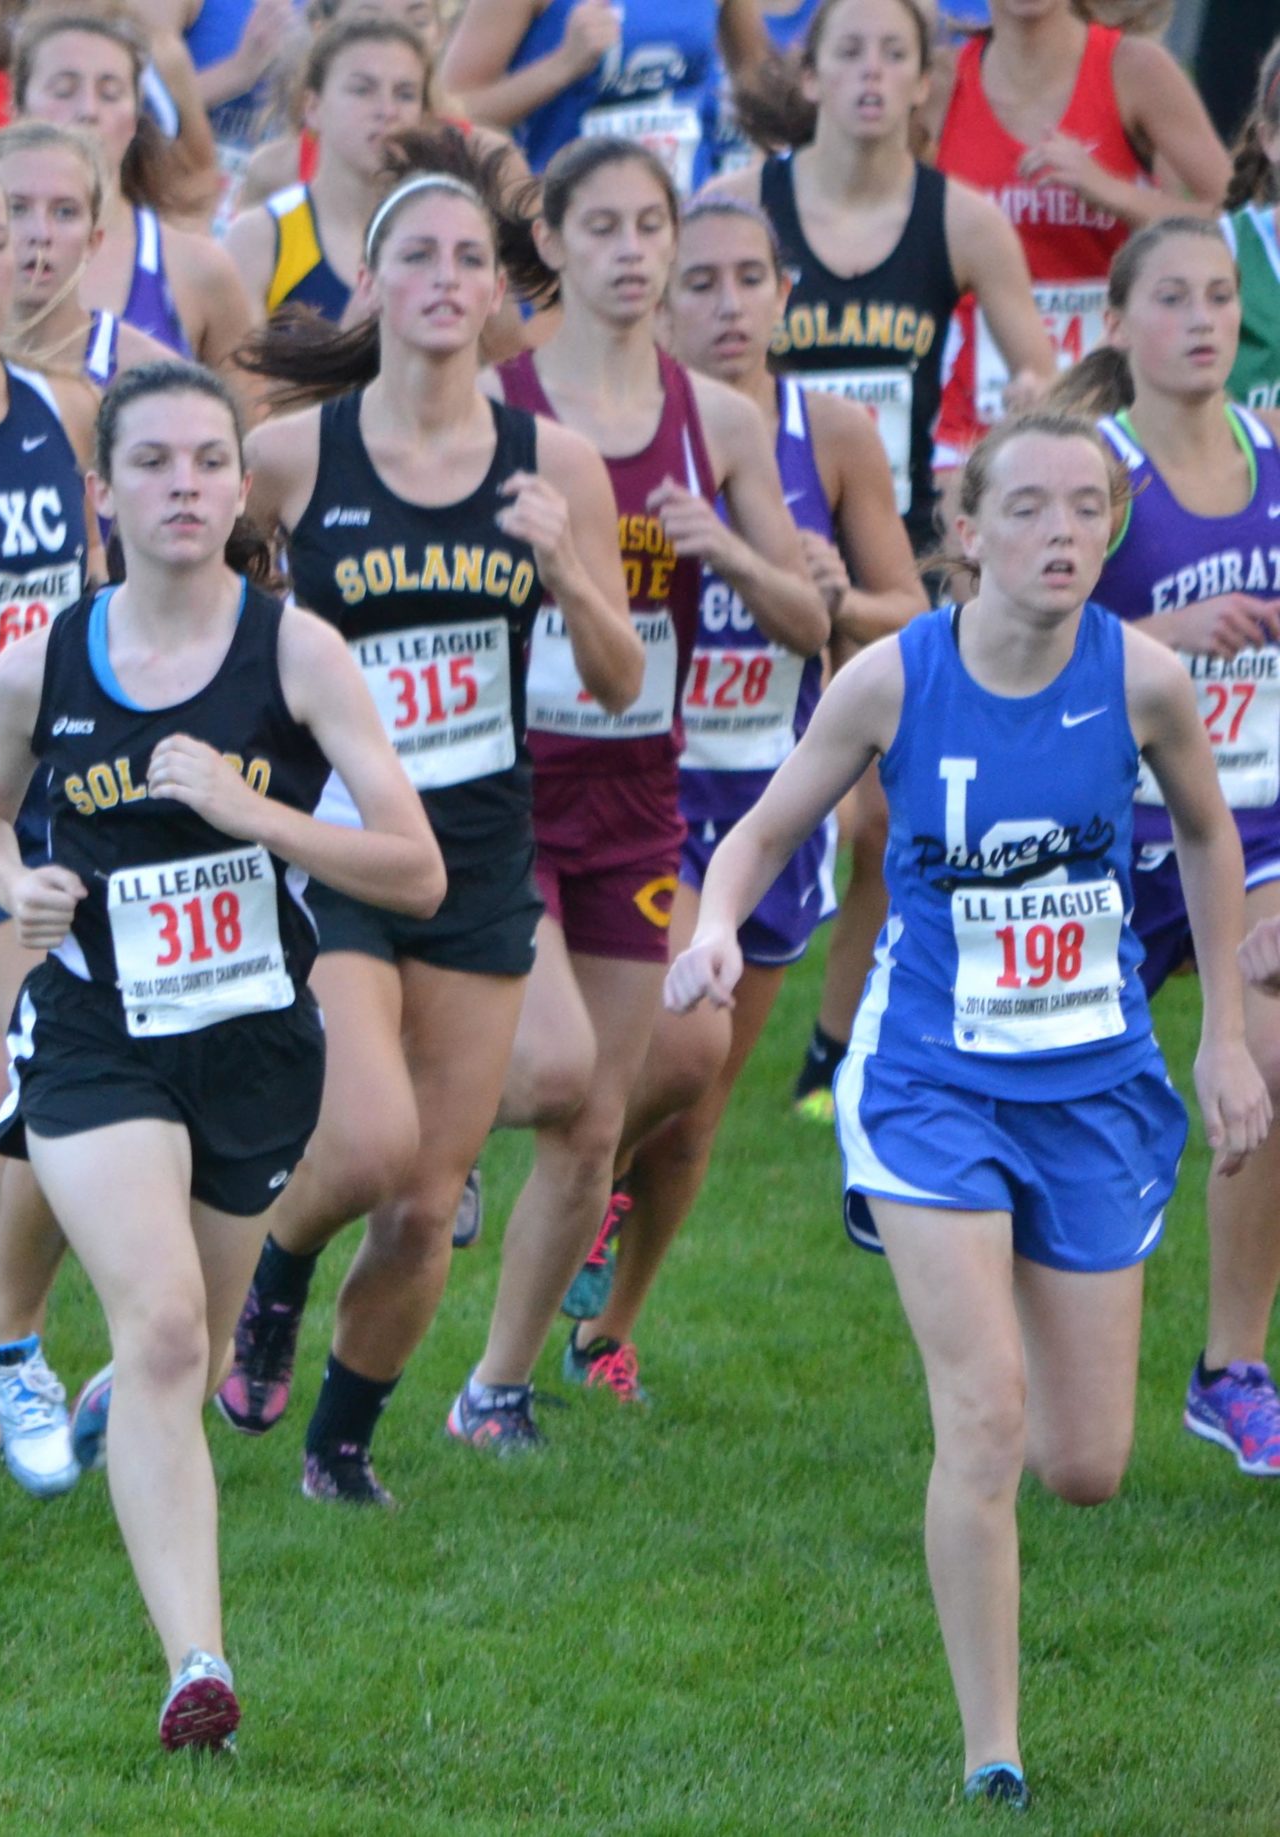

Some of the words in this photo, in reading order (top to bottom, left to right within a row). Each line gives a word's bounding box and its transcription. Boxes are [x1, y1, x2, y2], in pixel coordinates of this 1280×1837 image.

[334, 544, 535, 606] SOLANCO
[360, 643, 391, 668] LL
[399, 629, 499, 662] LEAGUE
[388, 656, 478, 729] 315
[686, 653, 774, 708] 128
[912, 813, 1116, 878] Pioneers
[119, 873, 151, 903] LL
[159, 855, 264, 900] LEAGUE
[964, 897, 997, 922] LL
[1005, 889, 1112, 921] LEAGUE
[148, 889, 243, 967] 318
[994, 920, 1086, 990] 198
[133, 978, 154, 998] 2014
[154, 975, 180, 996] CROSS
[181, 969, 215, 994] COUNTRY
[215, 953, 271, 986] CHAMPIONSHIPS
[965, 996, 986, 1016] 2014
[987, 998, 1013, 1016] CROSS
[1014, 995, 1048, 1015] COUNTRY
[1049, 984, 1110, 1011] CHAMPIONSHIPS
